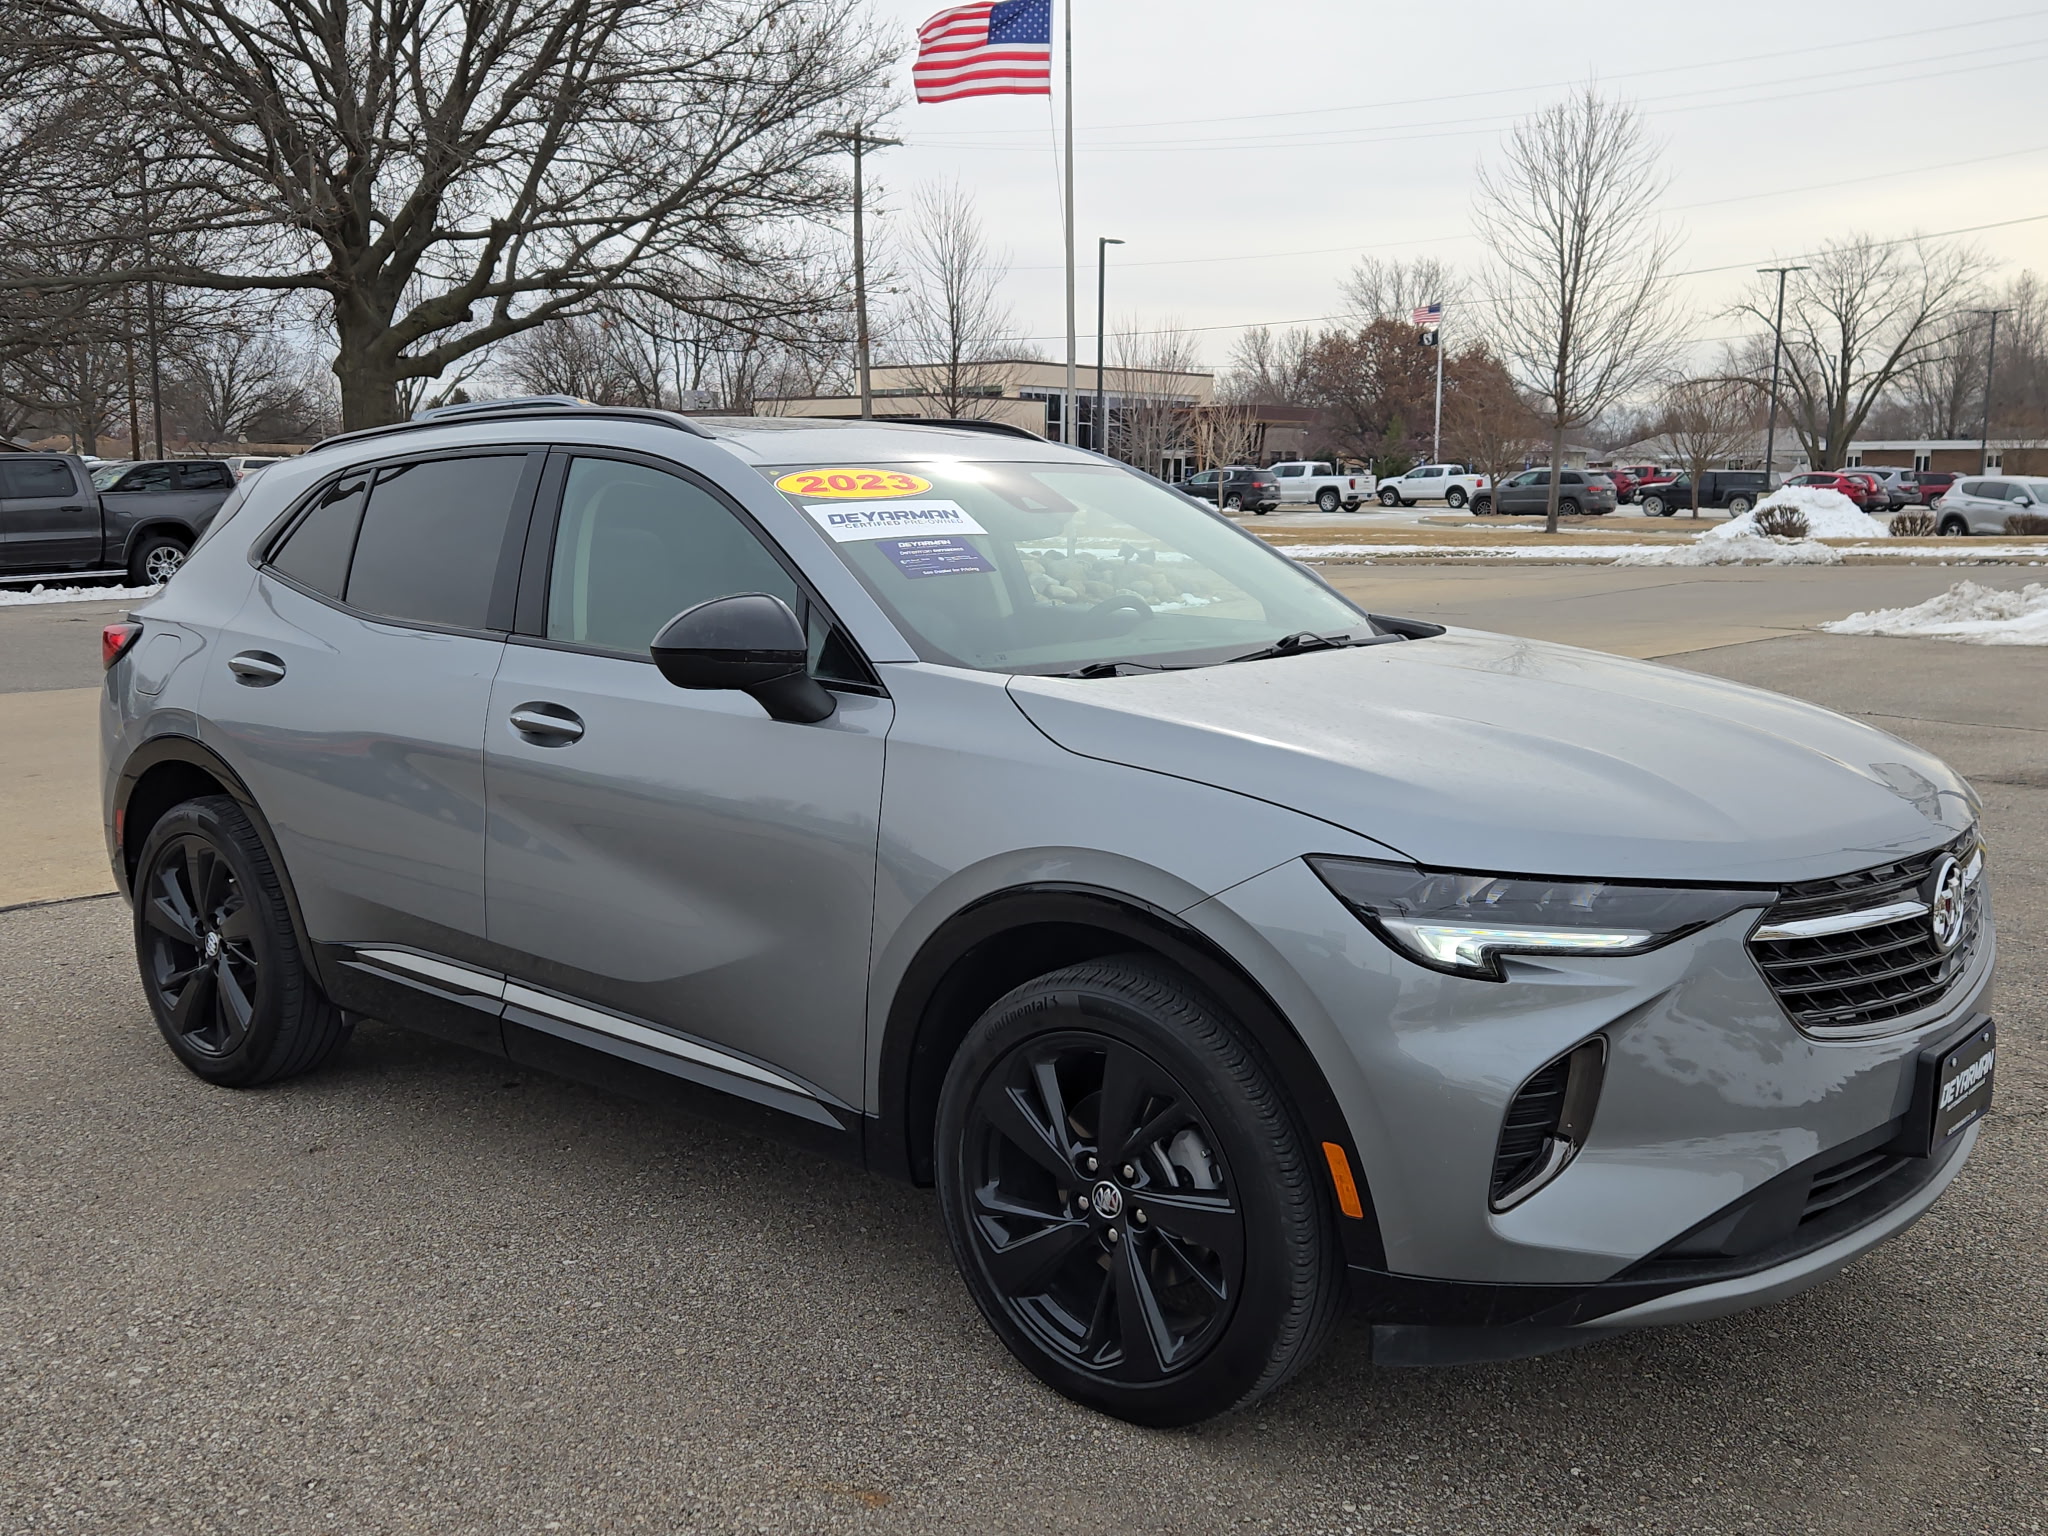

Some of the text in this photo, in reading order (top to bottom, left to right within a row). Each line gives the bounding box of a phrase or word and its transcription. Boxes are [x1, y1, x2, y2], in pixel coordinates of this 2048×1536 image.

[796, 474, 919, 493] 2023
[827, 509, 960, 525] DEYARMAN
[844, 518, 964, 529] CERTIFIED PRE-OWNED
[897, 540, 952, 548] DEYARMAN
[984, 996, 1048, 1041] Continental
[1939, 1048, 1995, 1110] DEYARMAN
